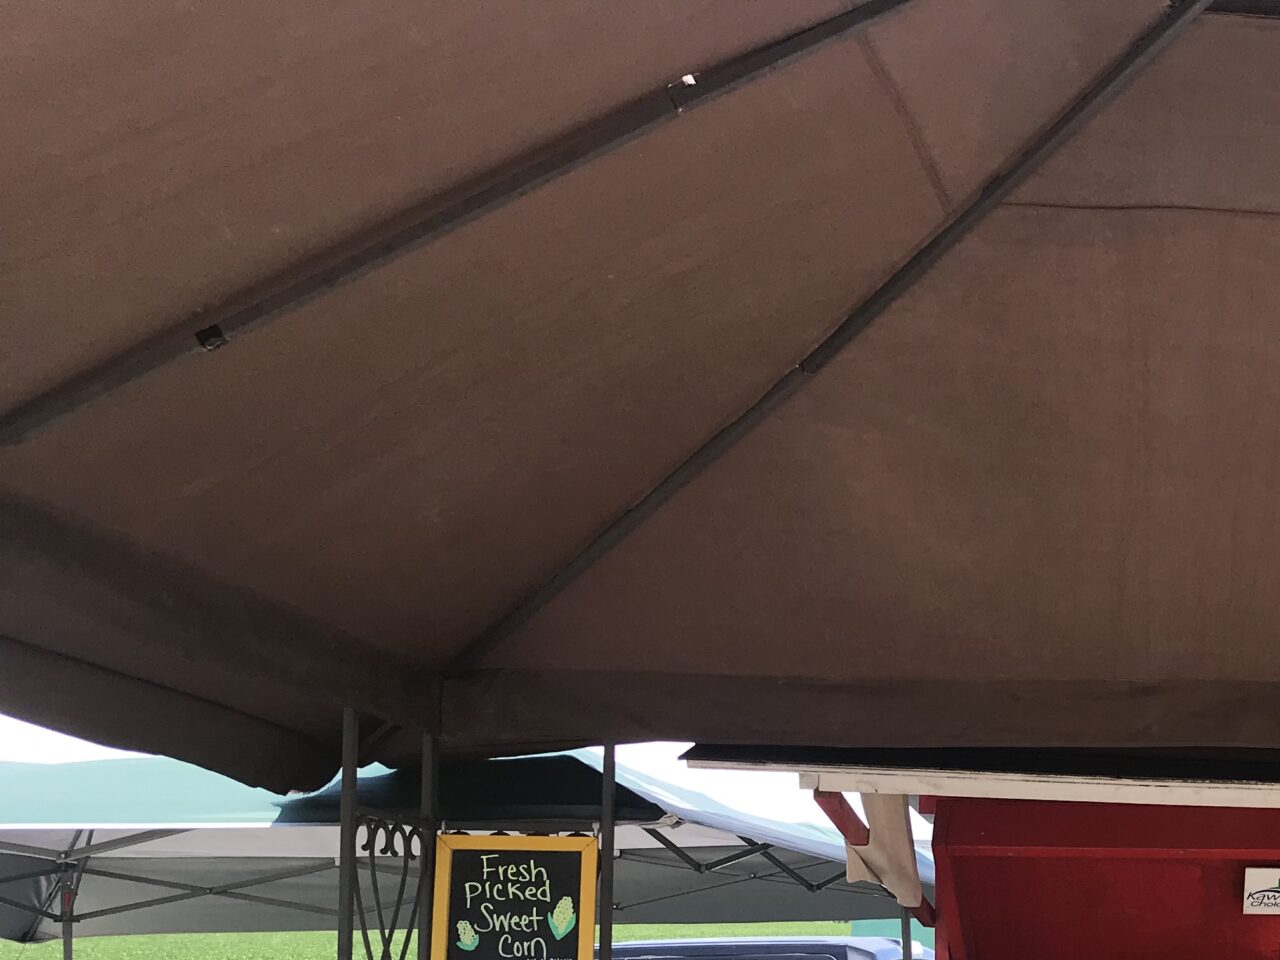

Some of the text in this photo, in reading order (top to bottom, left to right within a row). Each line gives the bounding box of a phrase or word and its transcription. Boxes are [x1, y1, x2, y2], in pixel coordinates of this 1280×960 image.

[480, 854, 547, 881] Fresh
[474, 903, 543, 932] Sweet
[498, 934, 547, 960] Corn
